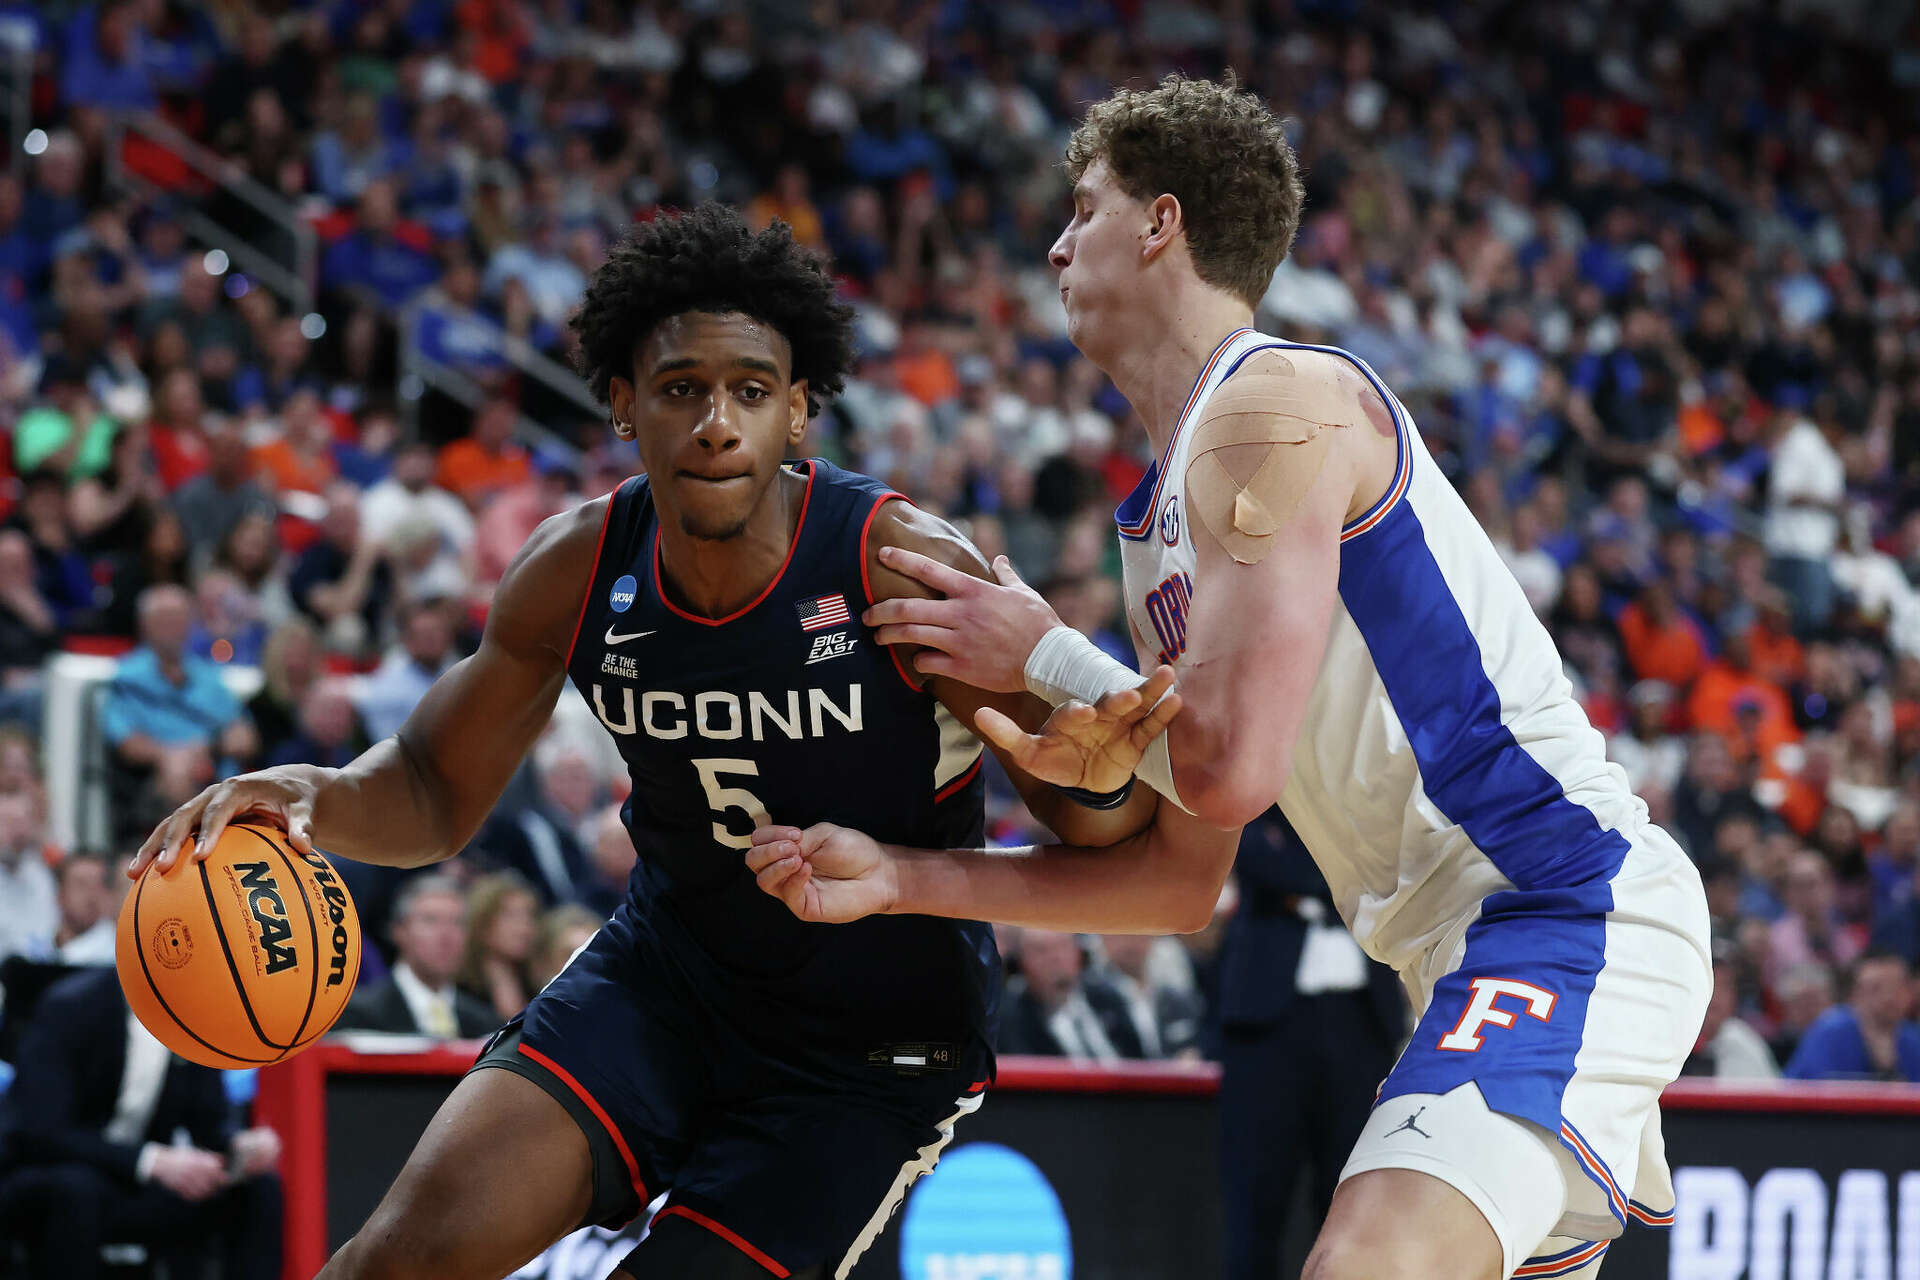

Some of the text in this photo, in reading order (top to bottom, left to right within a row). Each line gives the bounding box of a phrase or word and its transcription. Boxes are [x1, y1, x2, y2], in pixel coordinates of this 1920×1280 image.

[612, 592, 634, 603] NCAA
[808, 639, 858, 659] EAST
[812, 631, 847, 648] BIG
[601, 663, 638, 679] CHANGE
[604, 653, 636, 669] BE THE
[592, 683, 864, 742] UCONN
[690, 757, 773, 850] 5
[223, 865, 263, 977] OFFICIAL GAME BALL
[231, 861, 298, 976] NCAA
[1436, 976, 1560, 1052] F
[932, 1049, 949, 1062] 48
